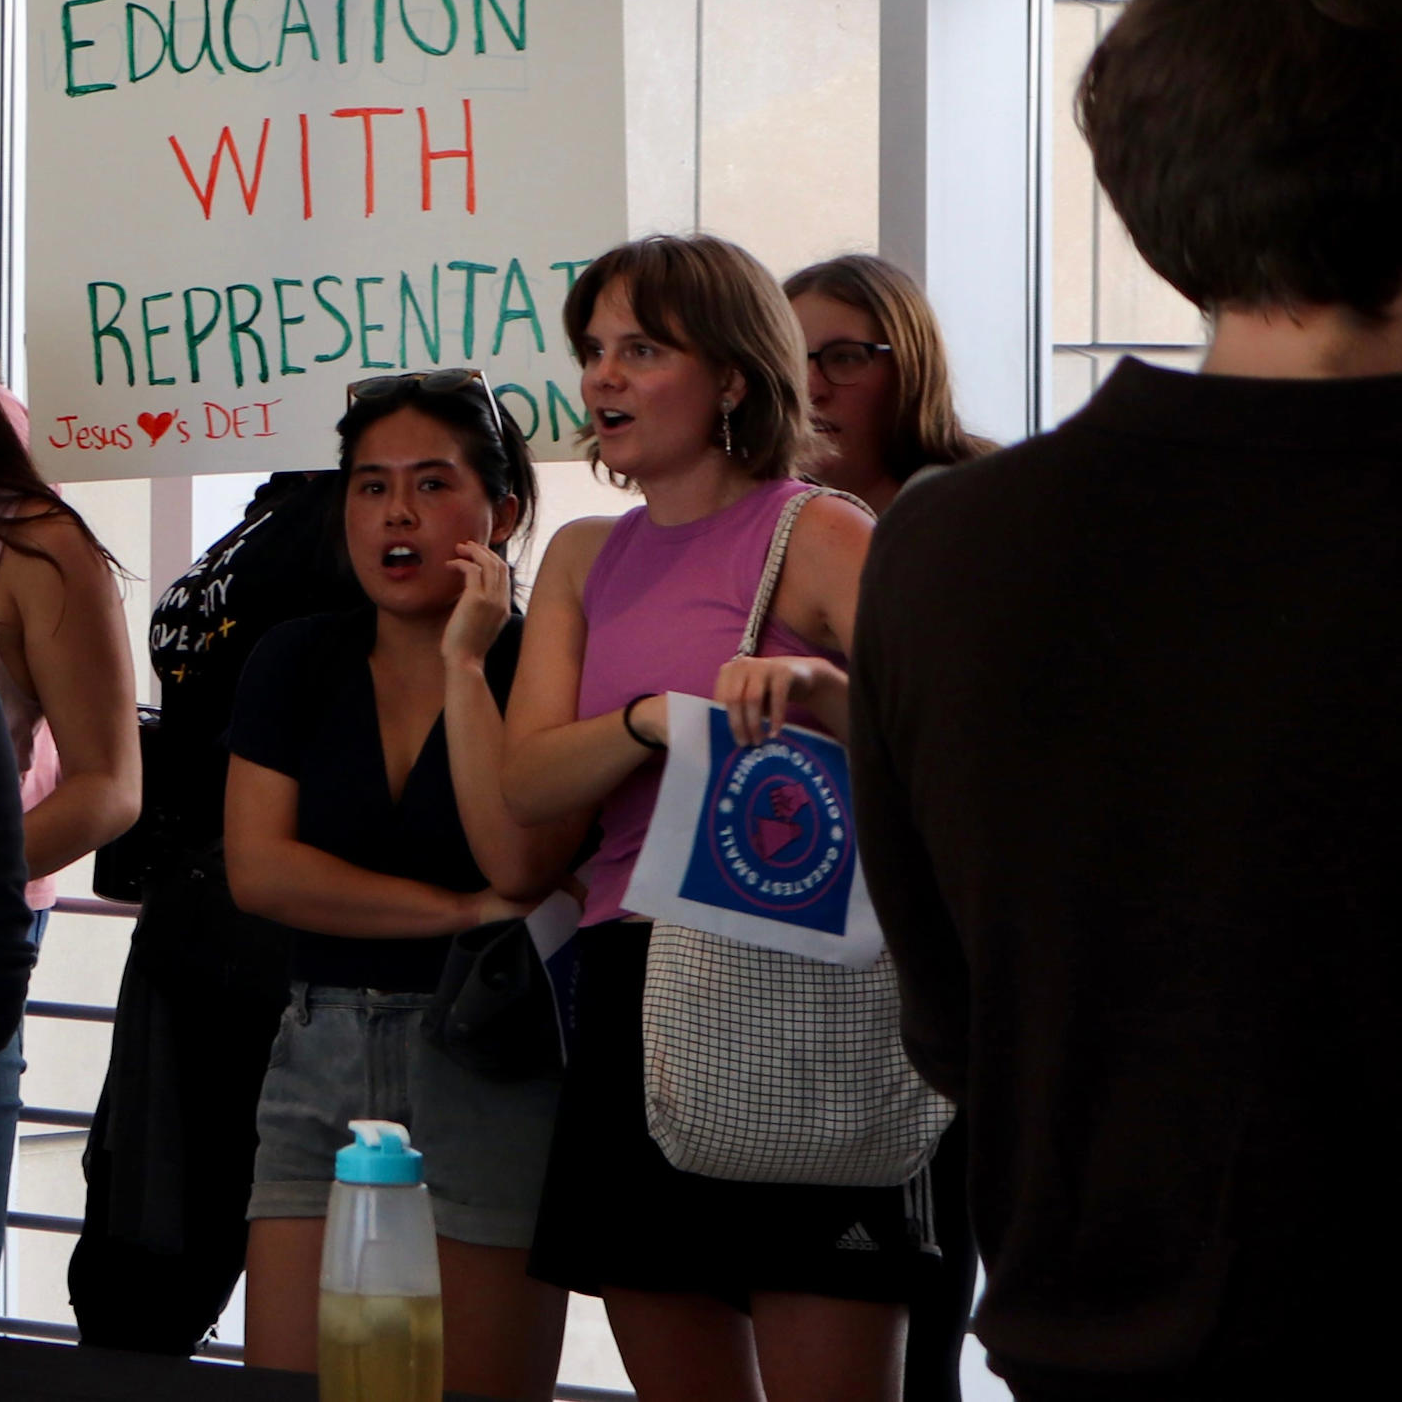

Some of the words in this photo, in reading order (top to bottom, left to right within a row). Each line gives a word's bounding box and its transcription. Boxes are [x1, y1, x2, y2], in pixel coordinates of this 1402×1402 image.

[168, 99, 476, 221] WITH
[49, 415, 132, 452] Jesus
[494, 380, 591, 442] ON
[812, 774, 840, 820] CITY
[719, 825, 759, 885] SMALL
[759, 846, 839, 896] GREATEST
